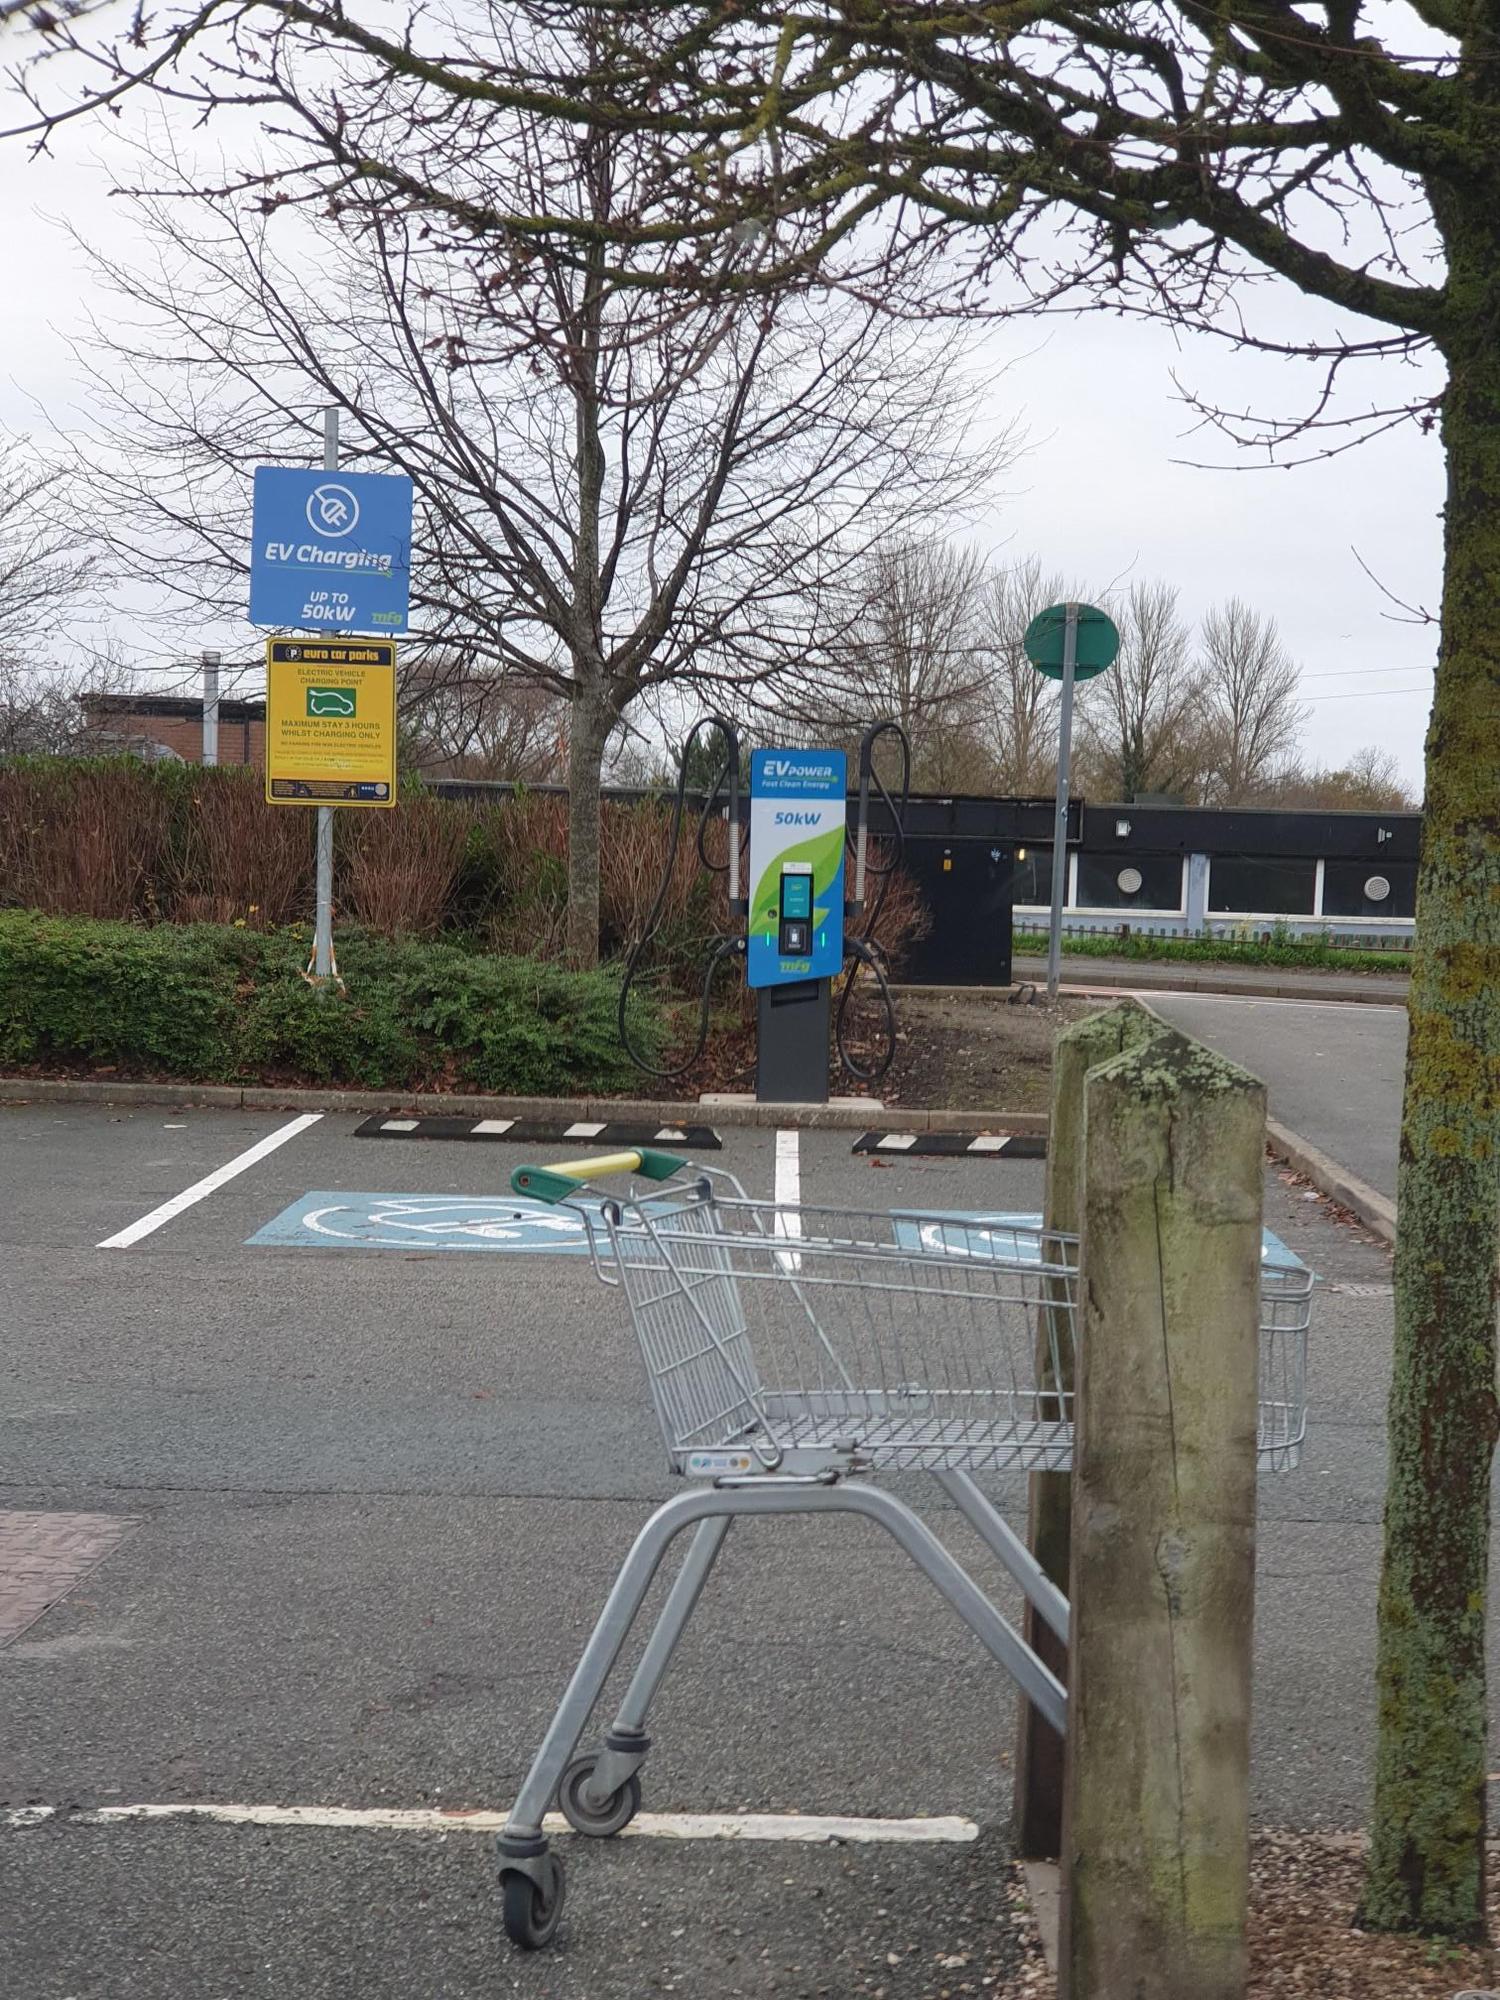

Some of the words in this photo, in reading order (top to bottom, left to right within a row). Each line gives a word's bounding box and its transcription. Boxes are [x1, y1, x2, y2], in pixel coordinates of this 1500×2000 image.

[265, 542, 295, 561] EV
[297, 545, 392, 570] Charging
[310, 591, 328, 603] UP
[331, 592, 349, 604] TO
[301, 604, 356, 621] 50kW
[303, 649, 329, 659] euro
[331, 650, 346, 660] car
[349, 650, 379, 661] parks
[297, 668, 333, 677] ELECTRIC
[300, 677, 339, 685] CHARGING
[281, 719, 320, 728] MAXIMUM
[322, 721, 343, 729] STAY
[351, 722, 381, 730] HOURS
[281, 729, 311, 737] WHILST
[313, 730, 357, 738] CHARGING
[358, 731, 381, 740] ONLY
[761, 780, 778, 788] Fast
[779, 780, 801, 788] Clean
[802, 780, 830, 790] Energy
[774, 811, 822, 825] 50kW
